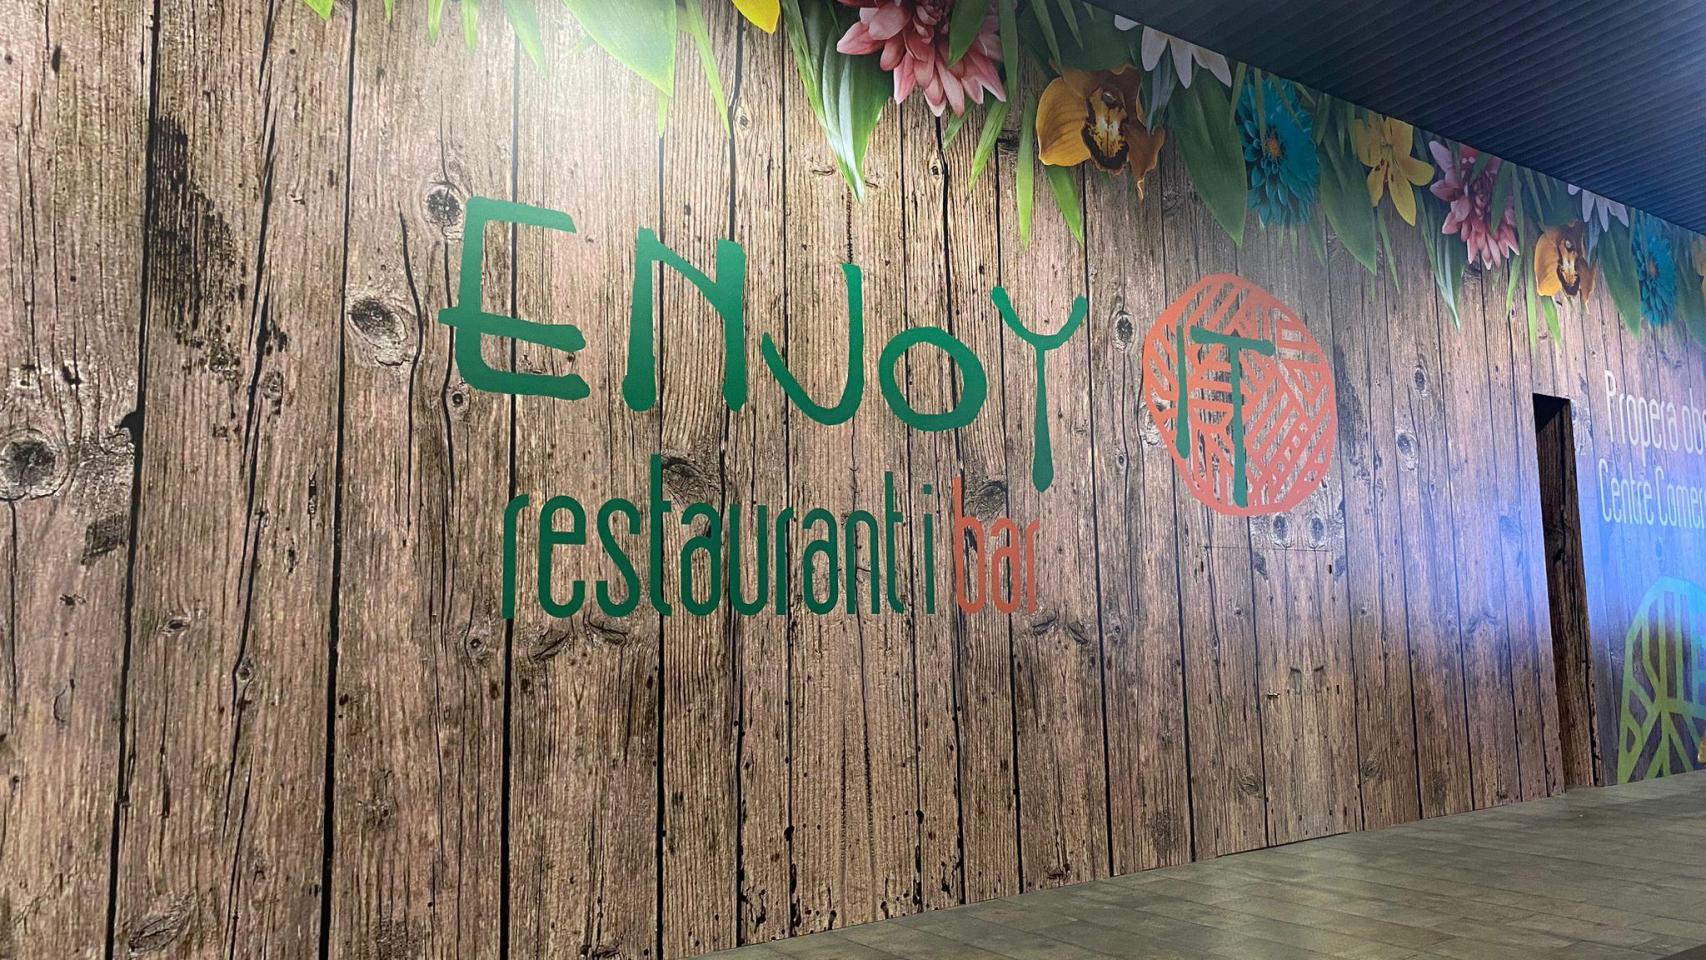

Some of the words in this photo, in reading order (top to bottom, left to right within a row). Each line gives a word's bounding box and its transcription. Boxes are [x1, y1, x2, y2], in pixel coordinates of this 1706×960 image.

[1176, 325, 1275, 508] IT
[1604, 370, 1679, 467] Propera
[502, 454, 905, 619] restaurant
[952, 476, 1041, 615] bar
[1598, 458, 1654, 525] Centre
[1655, 466, 1706, 529] Comer
